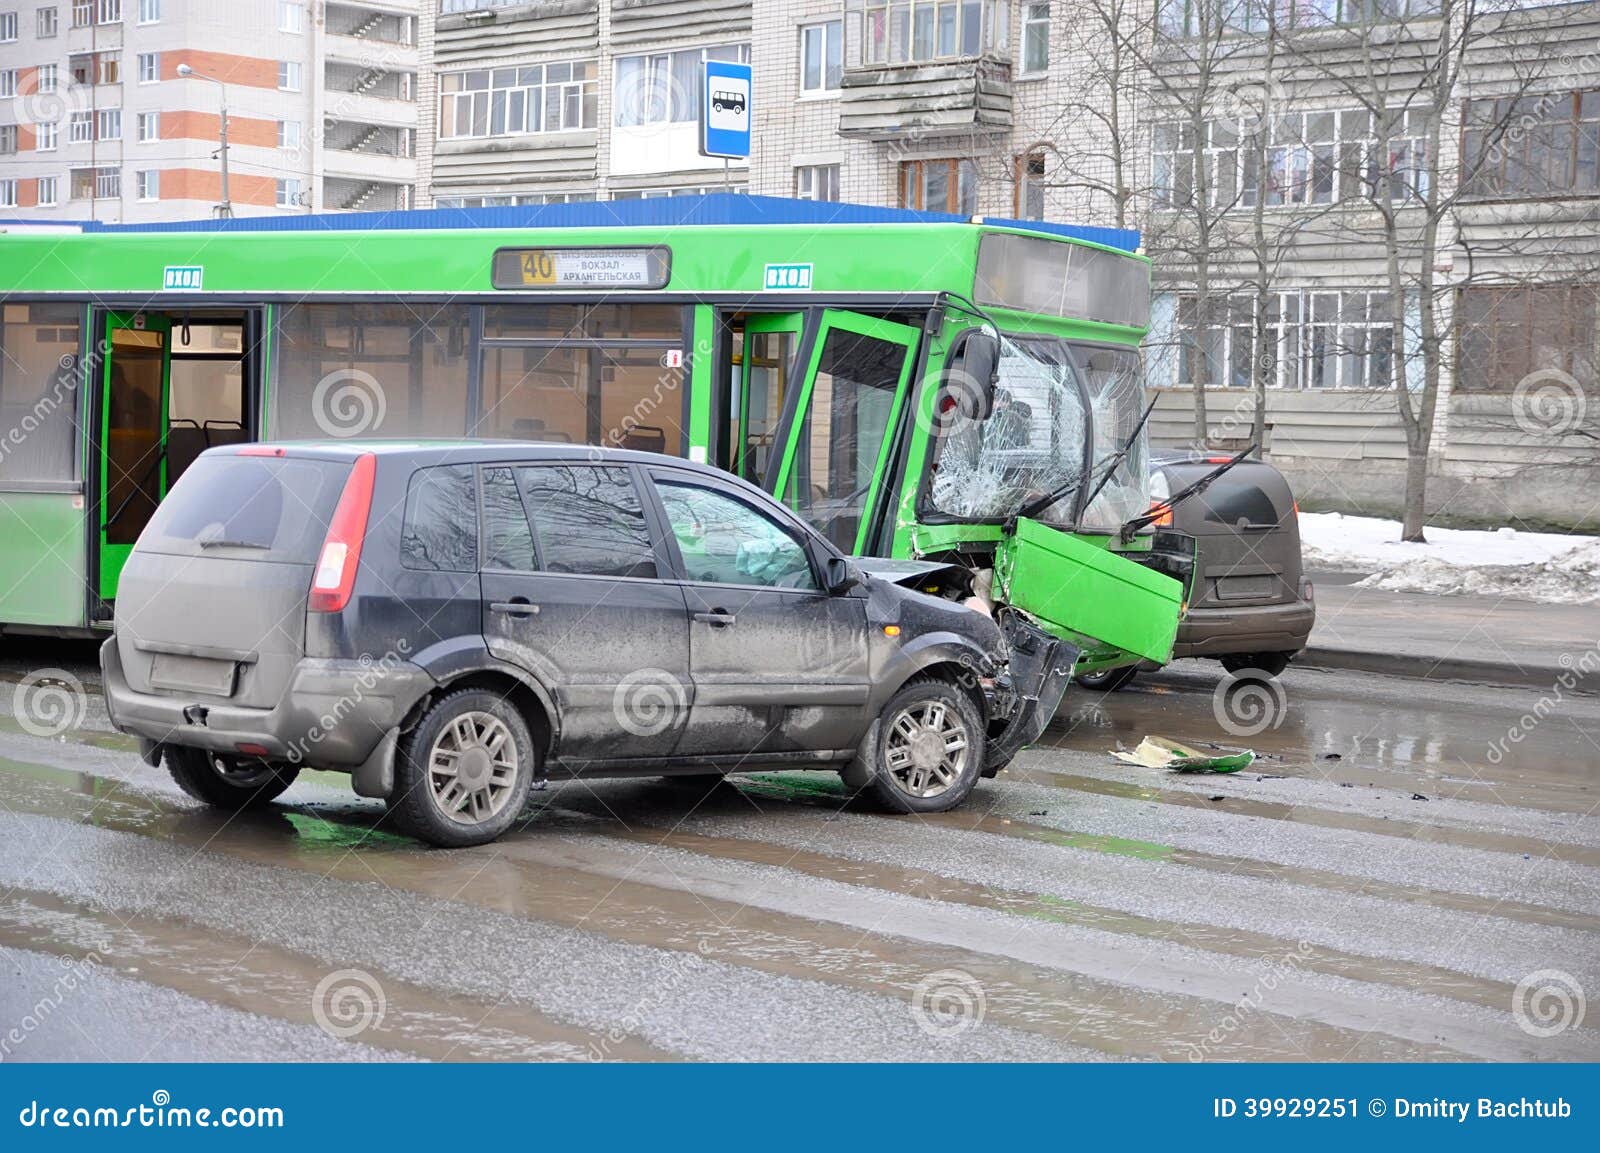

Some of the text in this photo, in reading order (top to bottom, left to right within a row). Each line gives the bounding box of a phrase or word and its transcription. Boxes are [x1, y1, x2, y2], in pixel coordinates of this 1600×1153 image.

[523, 253, 551, 278] 40
[581, 261, 620, 270] ВОКЗАЛ
[166, 270, 200, 287] ВХОД
[562, 271, 641, 281] АРХАНГЕЛЬСКАЯ
[766, 267, 809, 287] ВХОД
